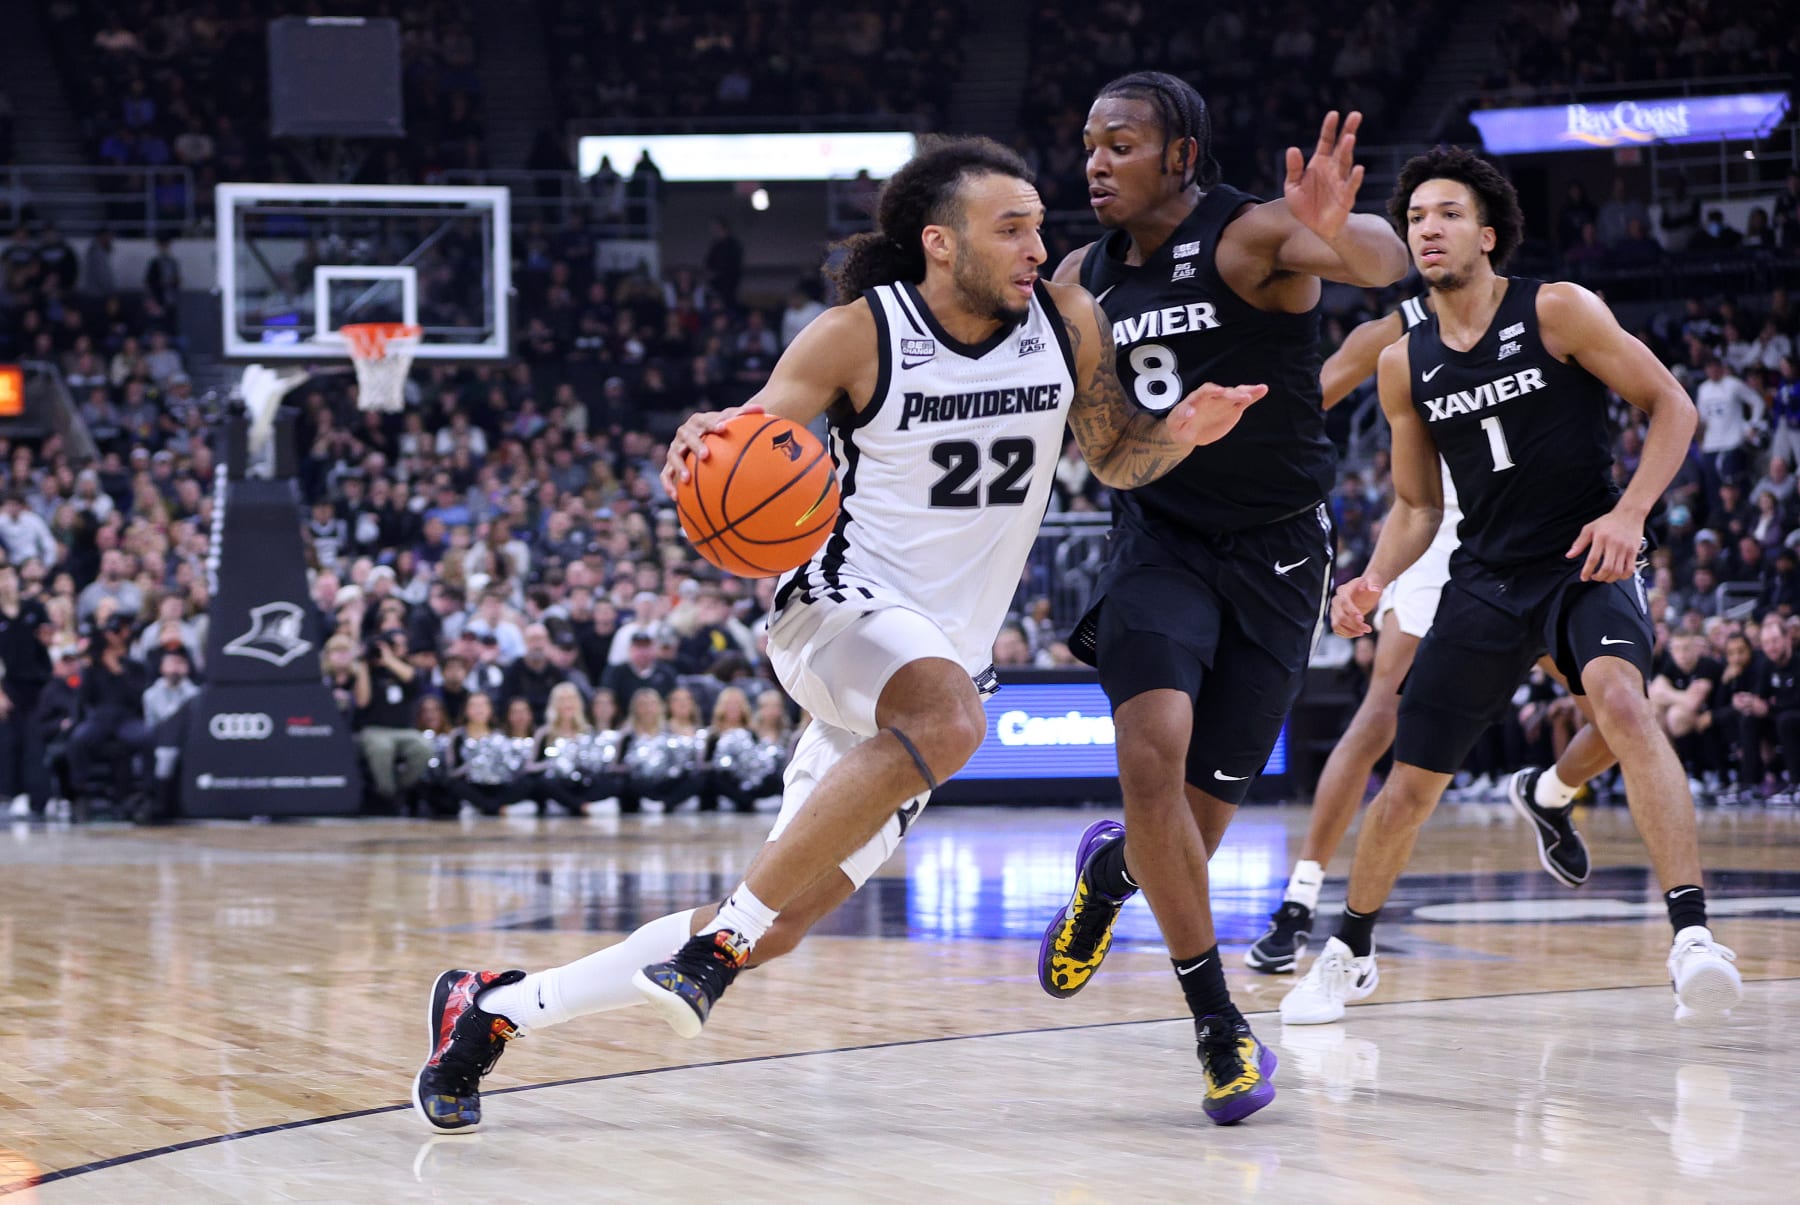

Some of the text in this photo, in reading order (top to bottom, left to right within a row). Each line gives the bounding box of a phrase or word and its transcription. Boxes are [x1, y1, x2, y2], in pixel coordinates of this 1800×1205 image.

[1172, 268, 1197, 278] EAST
[1020, 337, 1040, 347] BIG
[1112, 302, 1222, 346] AVIER
[1019, 343, 1046, 354] EAST
[1129, 343, 1183, 411] 8
[1422, 367, 1548, 422] XAVIER
[896, 383, 1062, 431] PROVIDENCE
[1480, 415, 1516, 472] 1
[928, 435, 1036, 509] 22
